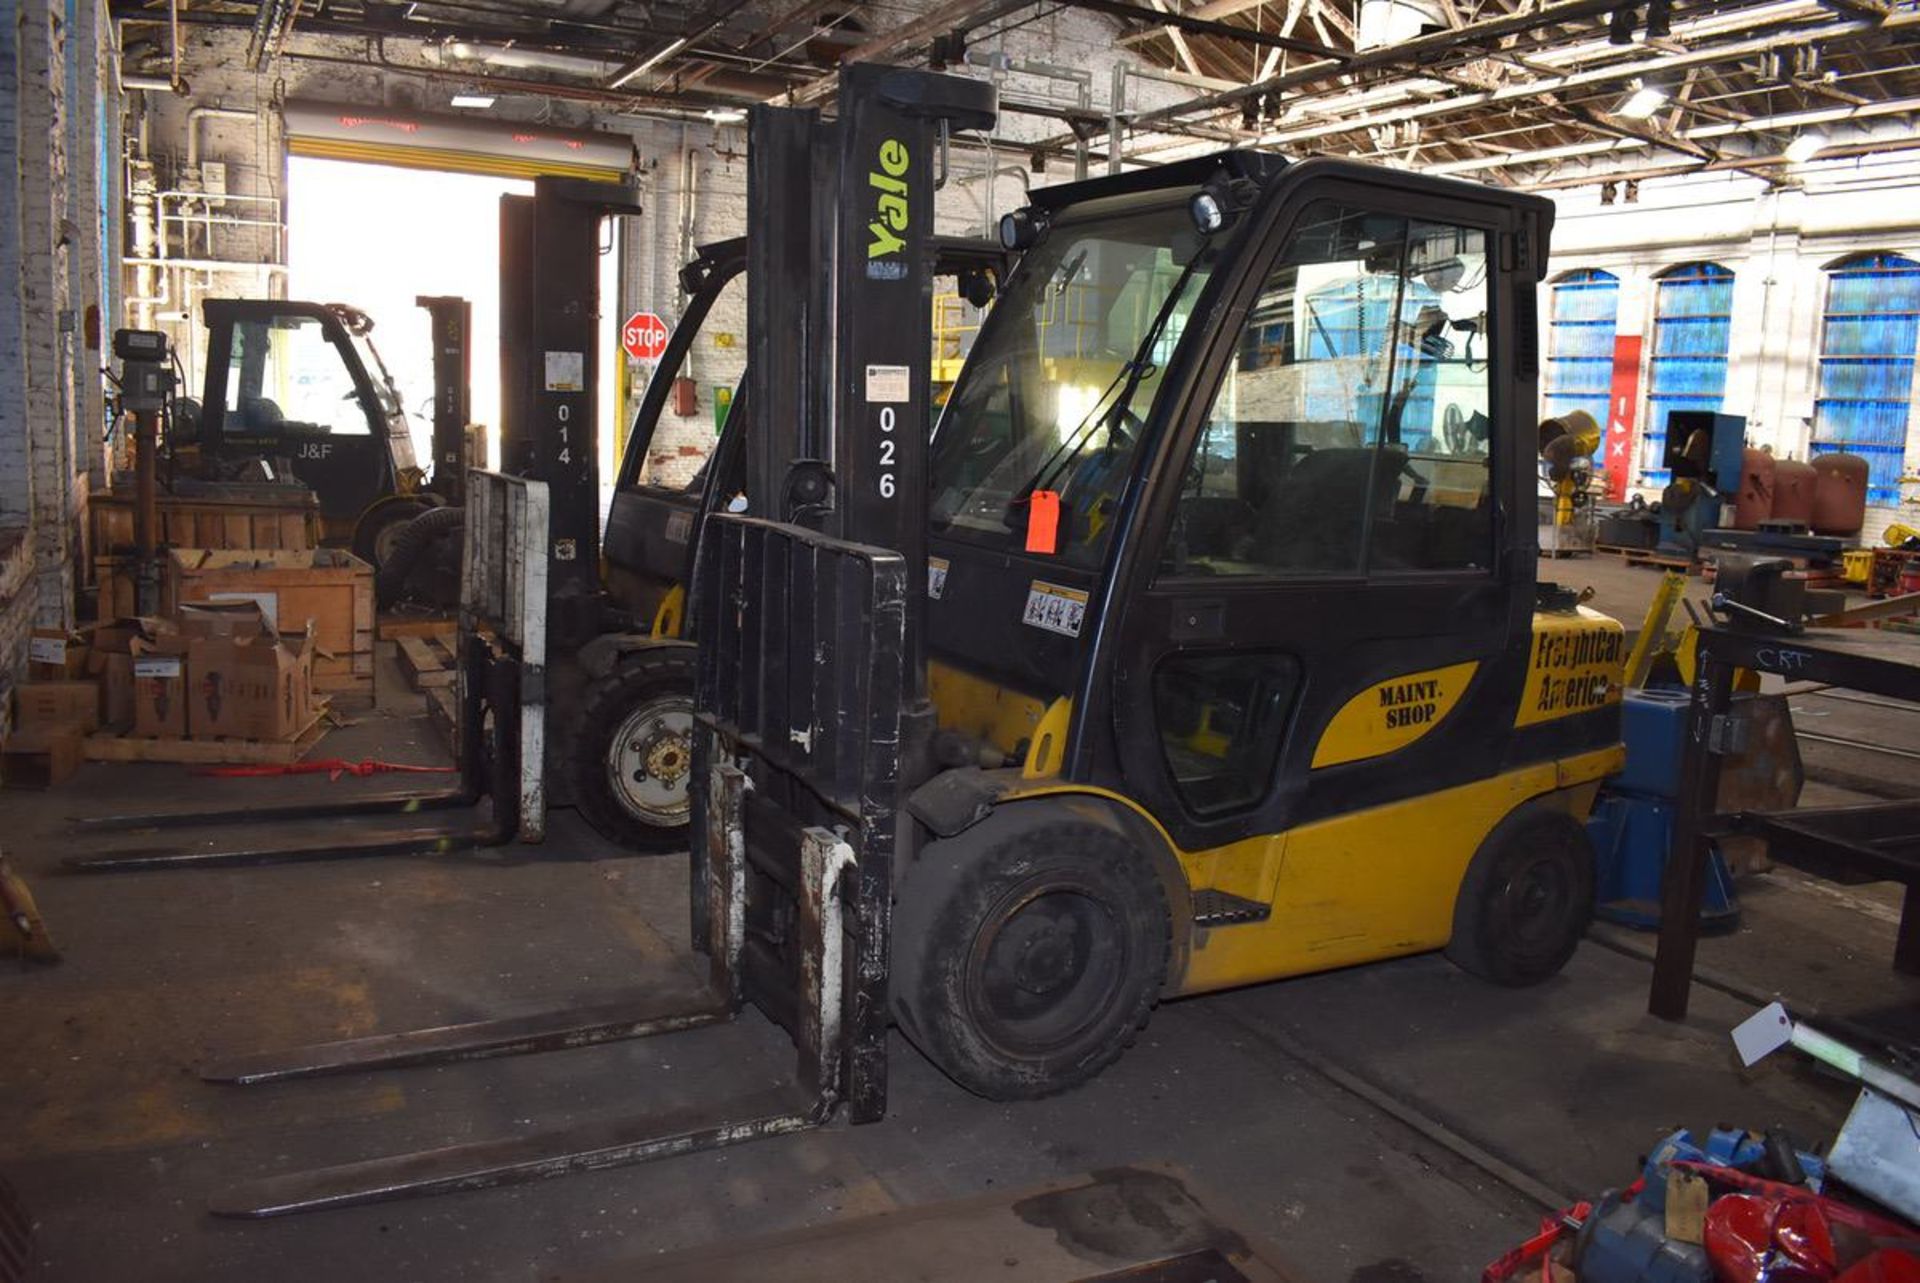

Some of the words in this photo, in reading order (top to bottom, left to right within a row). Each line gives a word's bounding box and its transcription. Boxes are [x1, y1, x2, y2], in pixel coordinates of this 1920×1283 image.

[868, 139, 909, 259] Yale
[626, 327, 665, 347] STOP
[297, 442, 333, 459] J&F
[879, 406, 896, 499] 026
[1379, 680, 1443, 708] MAINT.
[1386, 703, 1437, 729] SHOP
